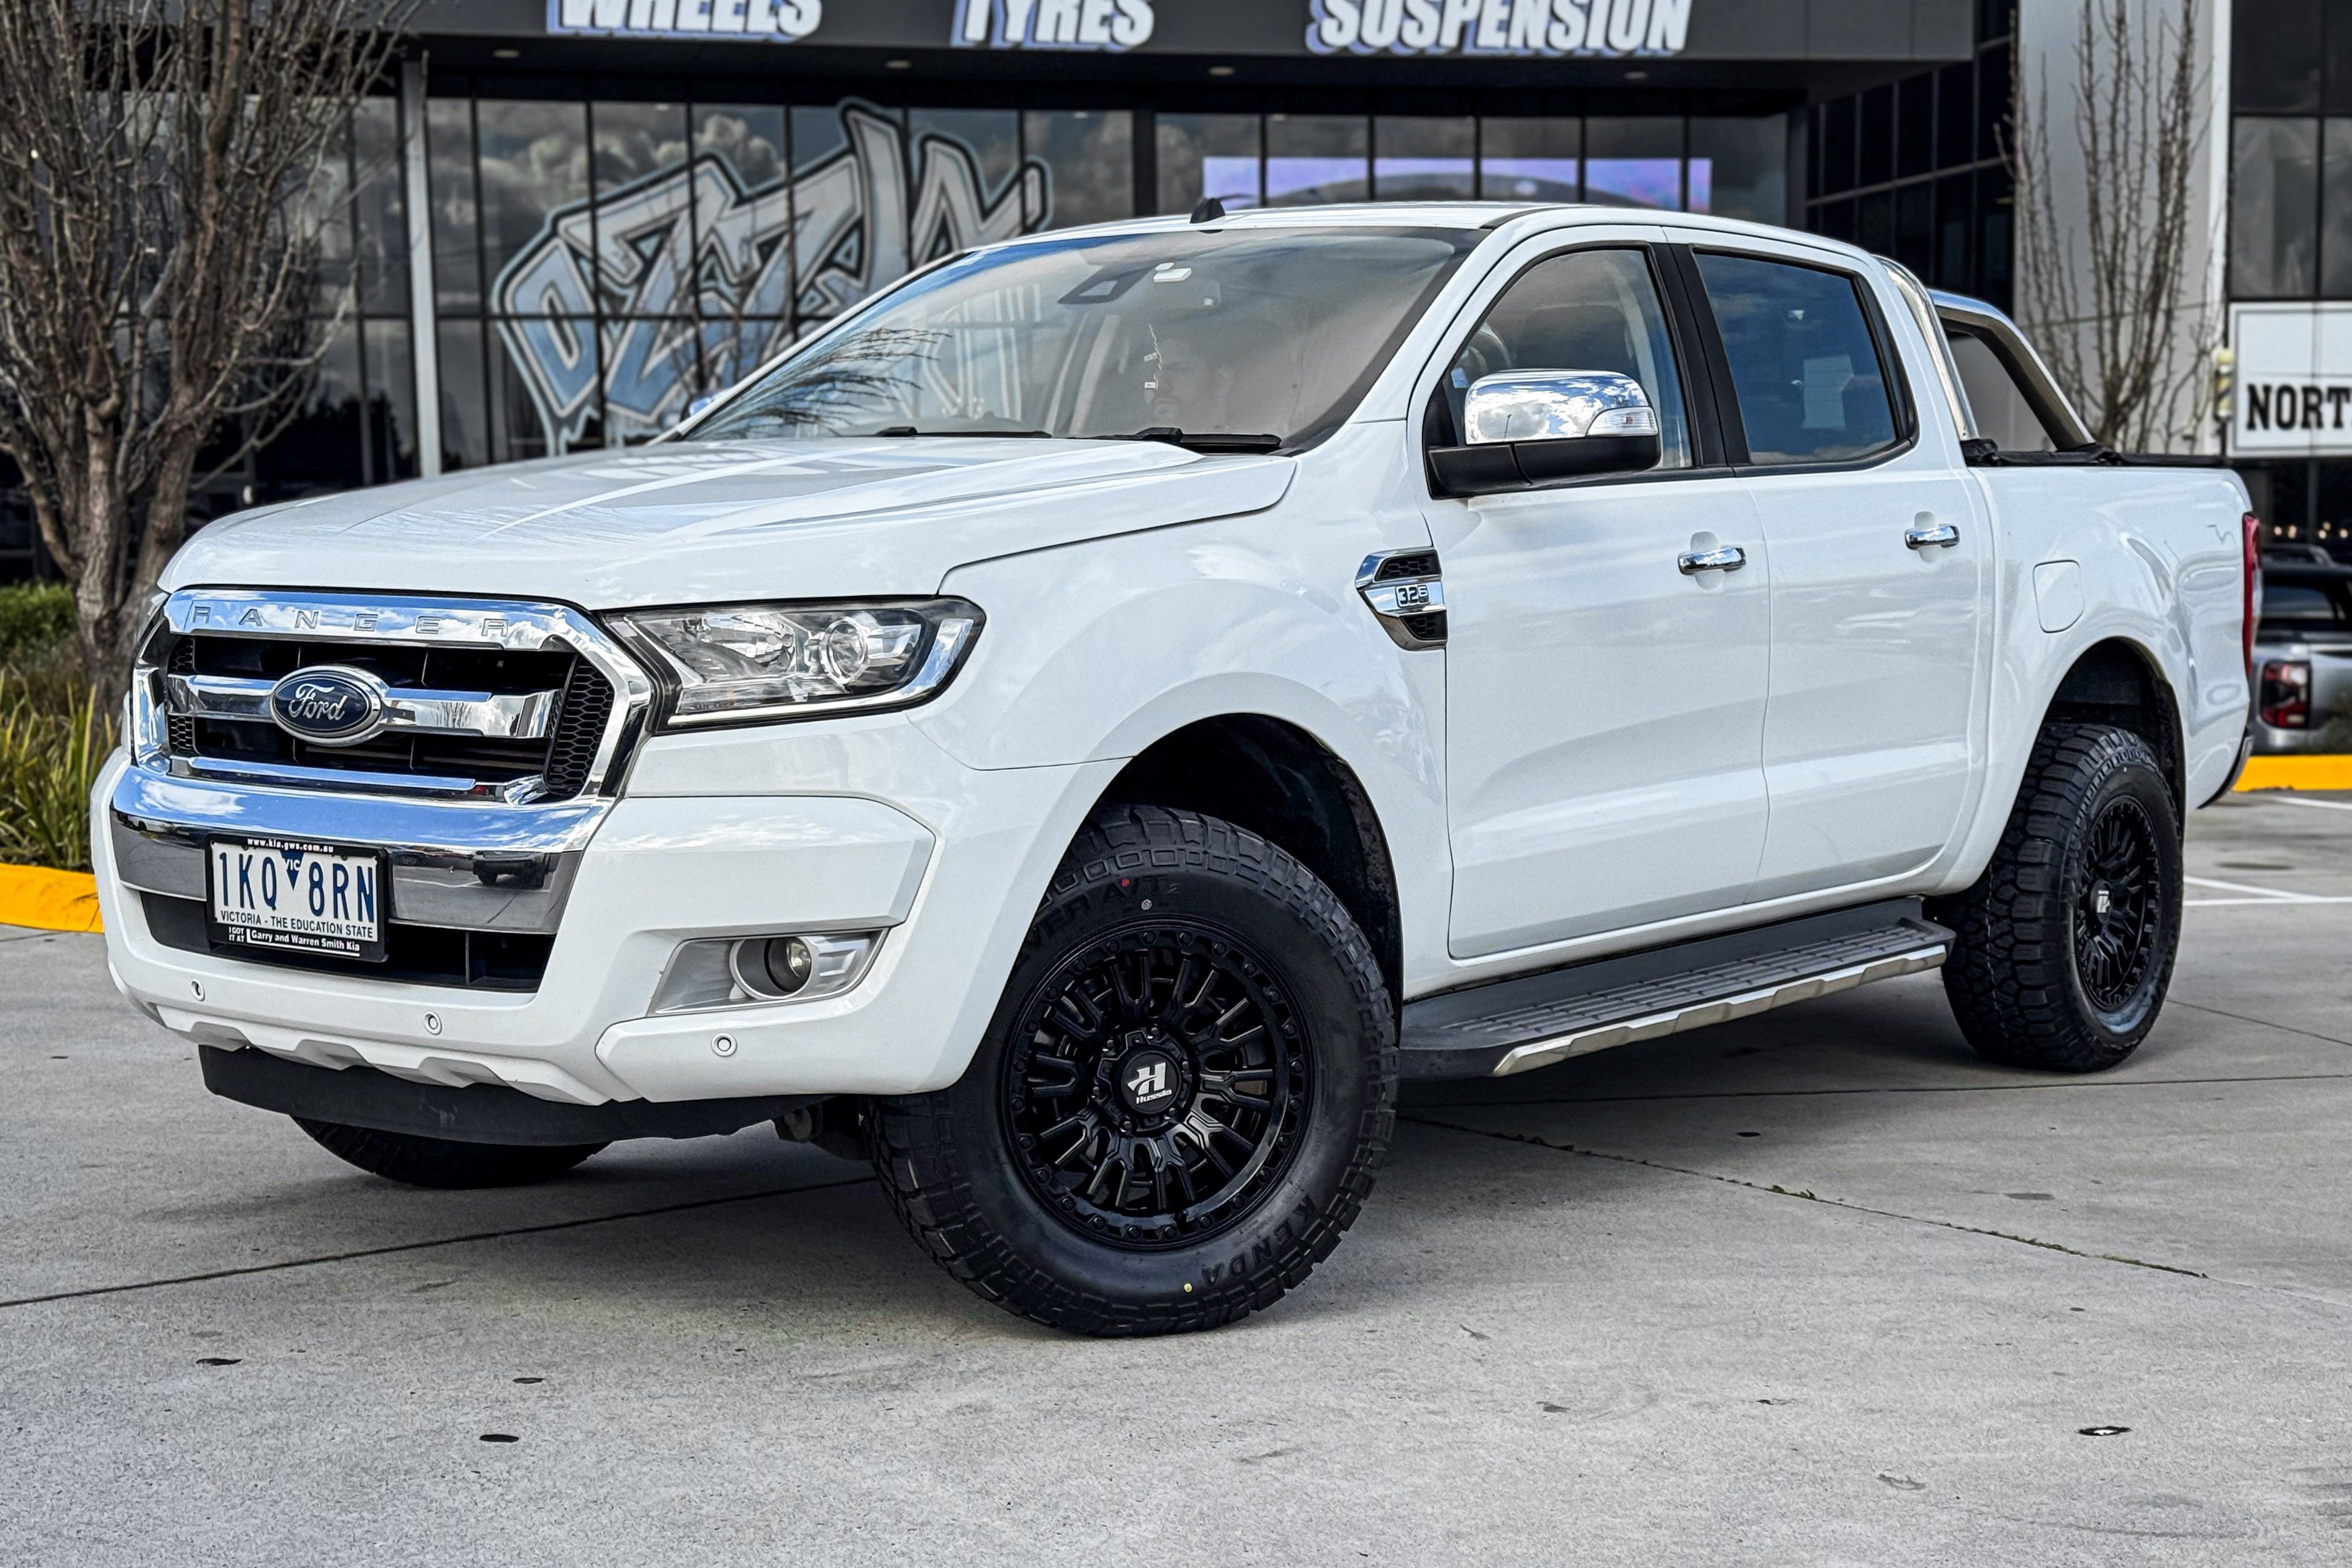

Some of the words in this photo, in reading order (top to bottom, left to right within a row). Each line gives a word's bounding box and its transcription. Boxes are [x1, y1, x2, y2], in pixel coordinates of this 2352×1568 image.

[950, 0, 1154, 52] TYRES
[1306, 0, 1691, 54] SUSPENSION
[2246, 383, 2352, 431] NORT
[191, 606, 509, 637] RANGER
[288, 683, 348, 720] Ford
[221, 910, 261, 925] VICTORIA
[270, 916, 288, 928] THE
[290, 918, 343, 935] EDUCATION
[346, 924, 373, 939] STATE
[251, 930, 273, 942] Garry
[275, 934, 289, 942] and
[291, 935, 319, 946] Warren
[321, 938, 345, 950] Smith
[346, 941, 360, 951] Kia
[1201, 1194, 1318, 1290] KENDA
